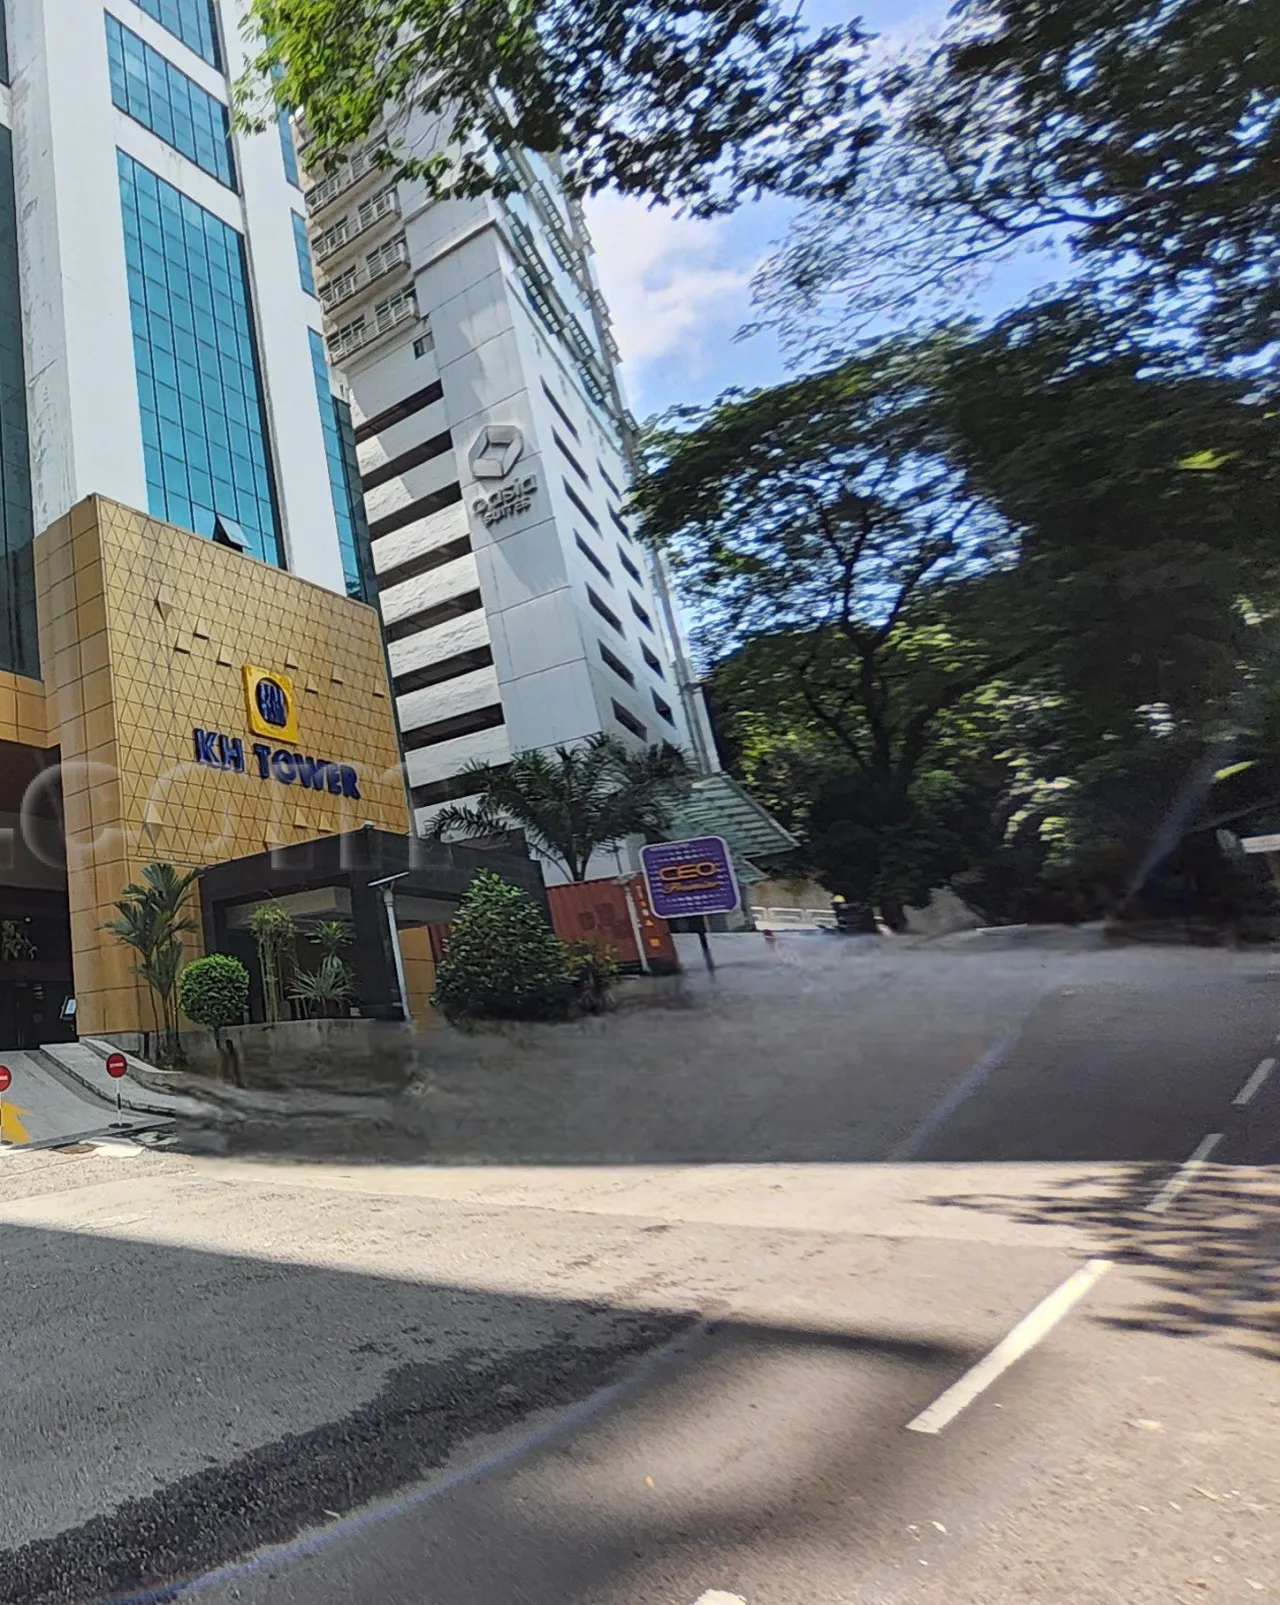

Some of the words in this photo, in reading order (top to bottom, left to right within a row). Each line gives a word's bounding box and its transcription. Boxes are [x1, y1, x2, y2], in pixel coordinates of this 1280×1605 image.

[484, 497, 531, 527] SUITES
[193, 727, 244, 773] KH
[254, 744, 361, 800] TOWER
[660, 862, 716, 881] CEO
